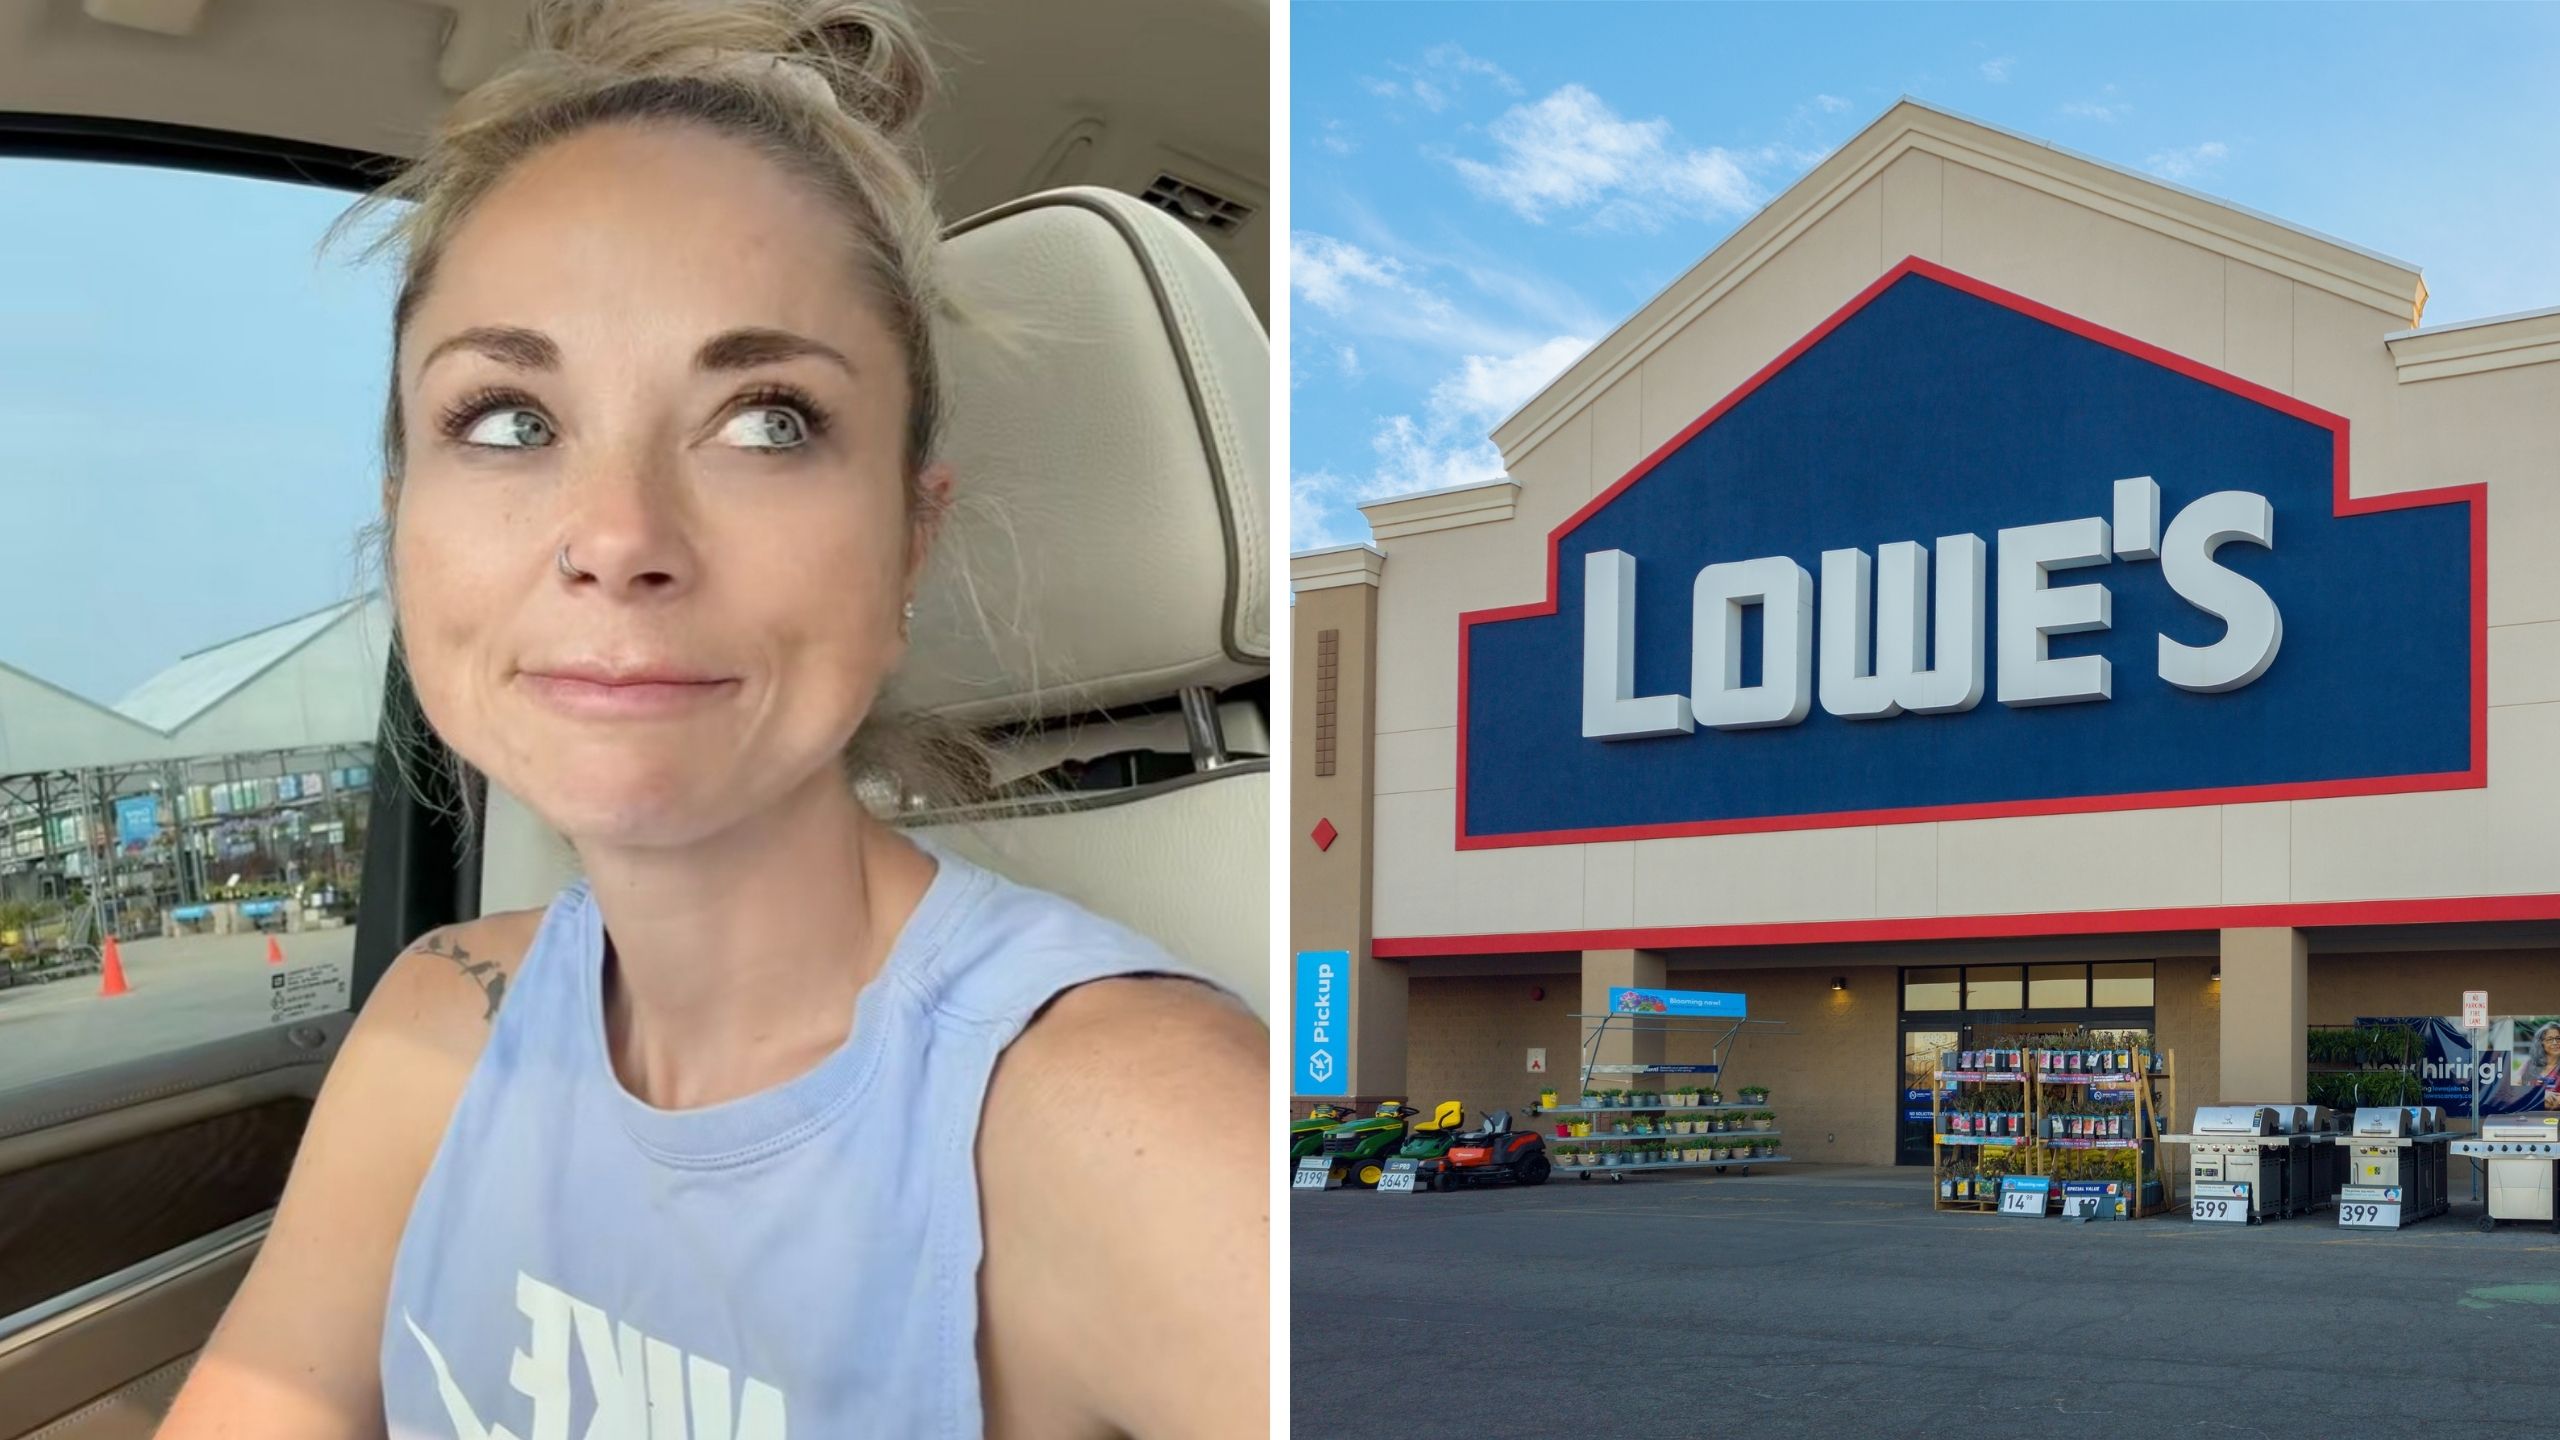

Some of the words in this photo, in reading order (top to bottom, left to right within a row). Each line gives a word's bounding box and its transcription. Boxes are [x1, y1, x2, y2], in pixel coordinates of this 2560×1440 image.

[1582, 475, 2283, 742] LOWE'S
[1314, 963, 1334, 1043] Pickup
[1669, 997, 1703, 1007] Blooming
[1295, 1171, 1322, 1185] 3199
[1380, 1174, 1409, 1188] 3649
[2007, 1194, 2025, 1210] 14
[2195, 1201, 2228, 1218] 599
[2342, 1205, 2378, 1222] 399
